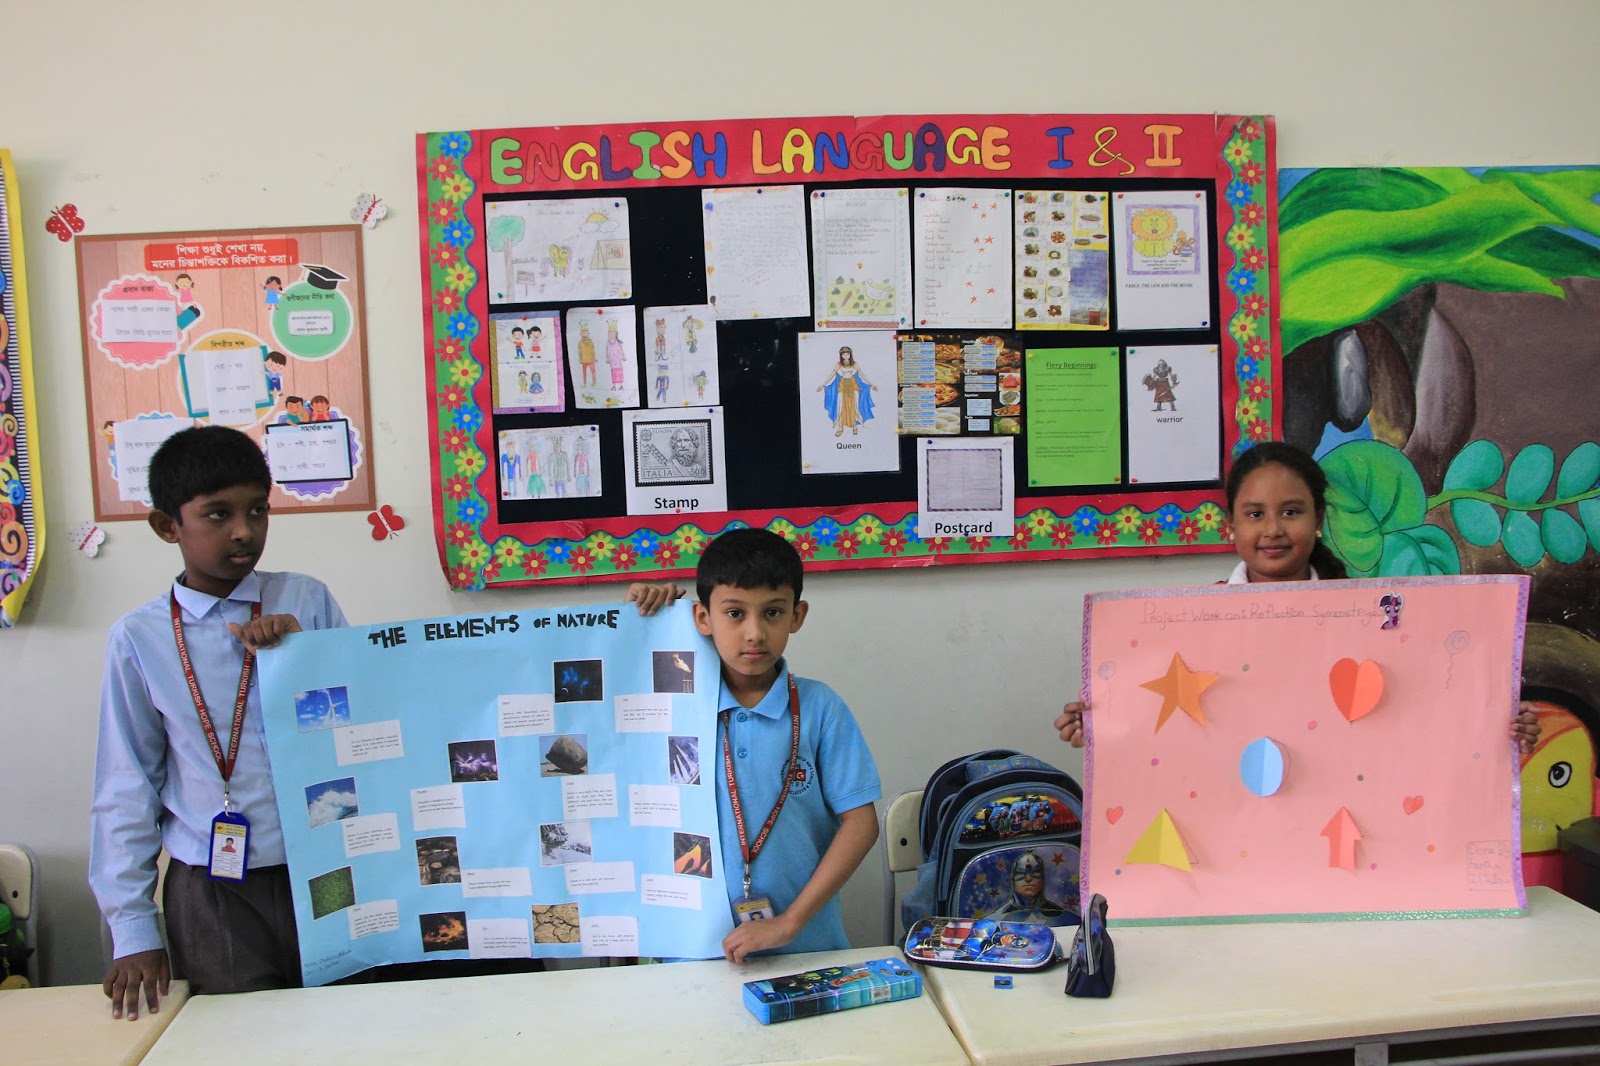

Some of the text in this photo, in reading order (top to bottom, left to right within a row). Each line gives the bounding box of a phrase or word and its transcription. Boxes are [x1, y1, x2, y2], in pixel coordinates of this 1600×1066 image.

[489, 122, 1183, 185] ENGLISH LANGUAGE I & II
[151, 259, 176, 268] মনের
[176, 244, 199, 255] শিক্ষা
[226, 243, 247, 253] শেখা
[1046, 362, 1062, 370] Fiery
[654, 497, 699, 510] Stamp
[935, 522, 992, 534] Postcard
[368, 610, 620, 648] THE ELEMENTS OF NATURE
[174, 618, 222, 763] INTERNATIONAL TURKISH HOPE SCHOOL
[228, 699, 245, 760] INTERNATIONAL
[239, 665, 250, 698] TURKISH
[792, 714, 800, 770] INTERNATIONAL
[725, 754, 736, 788] TURKISH
[778, 772, 793, 804] TURKISH
[730, 788, 746, 846] INTERNATIONAL
[767, 806, 780, 826] HOPE
[752, 828, 769, 854] SCHOOL
